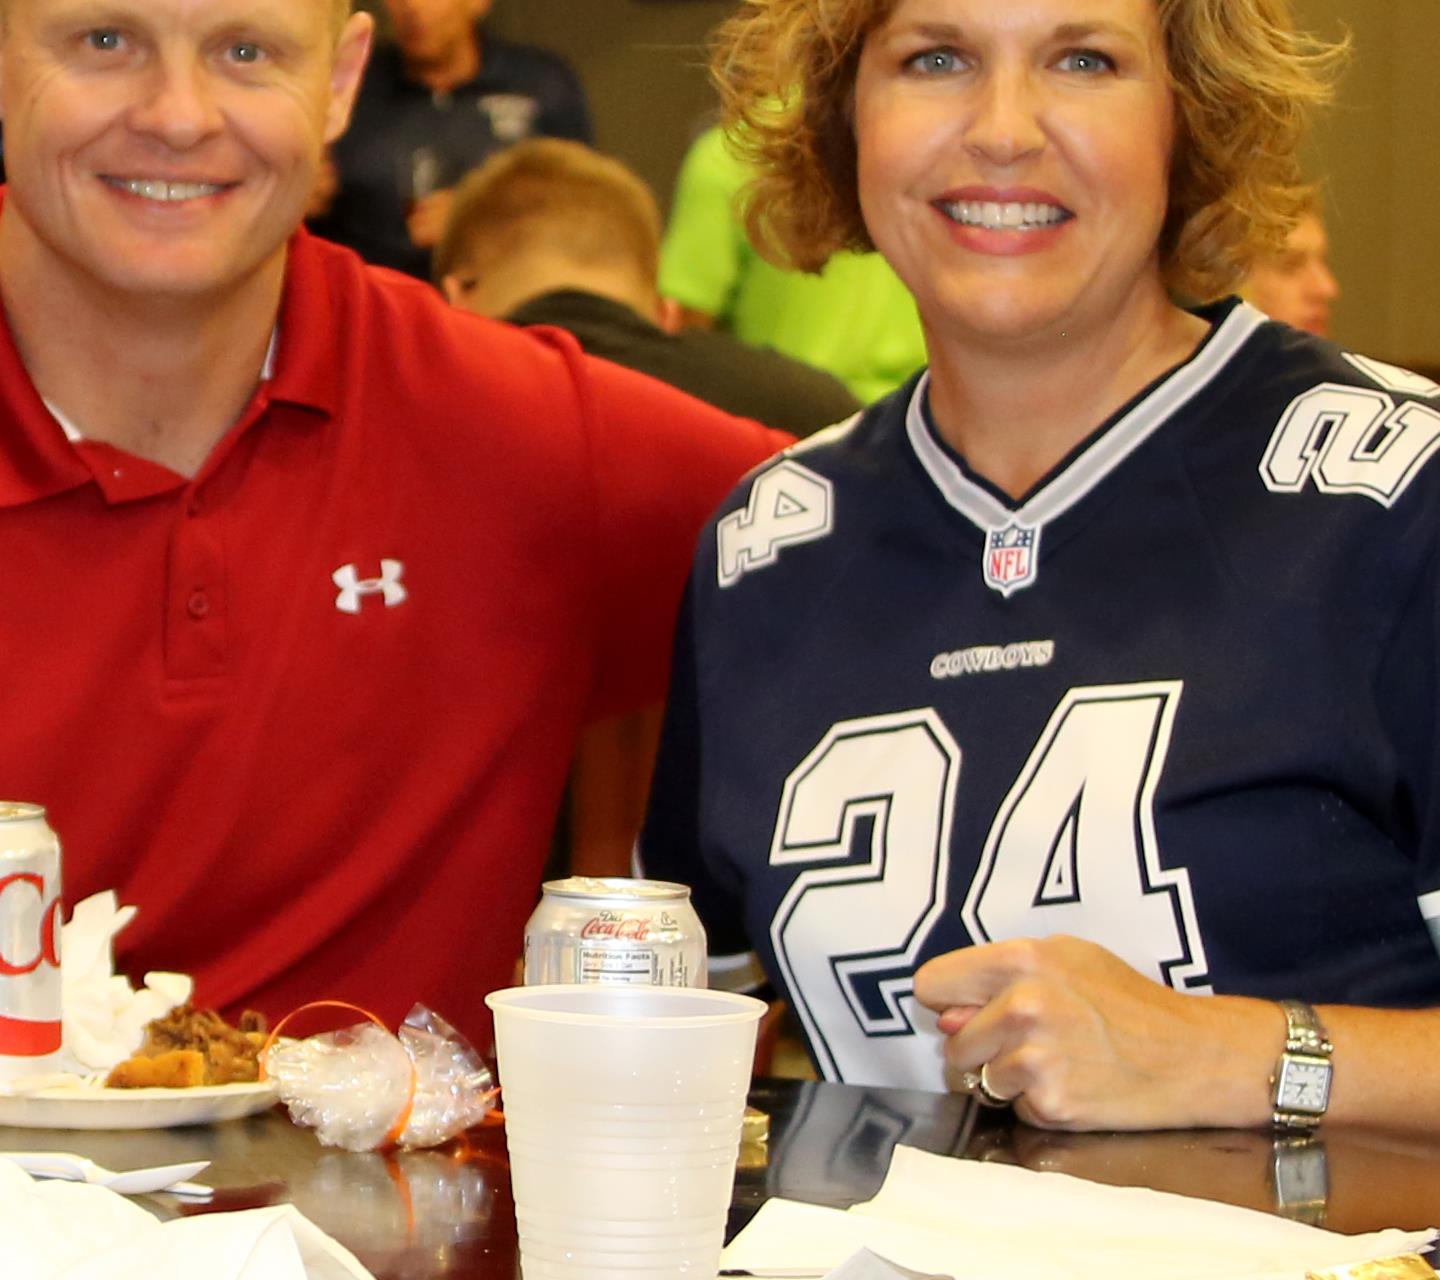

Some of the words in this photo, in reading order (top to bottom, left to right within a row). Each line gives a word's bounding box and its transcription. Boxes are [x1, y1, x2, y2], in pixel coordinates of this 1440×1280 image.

[989, 548, 1027, 581] NFL
[929, 639, 1055, 679] COWBOYS
[770, 679, 1213, 1084] 24
